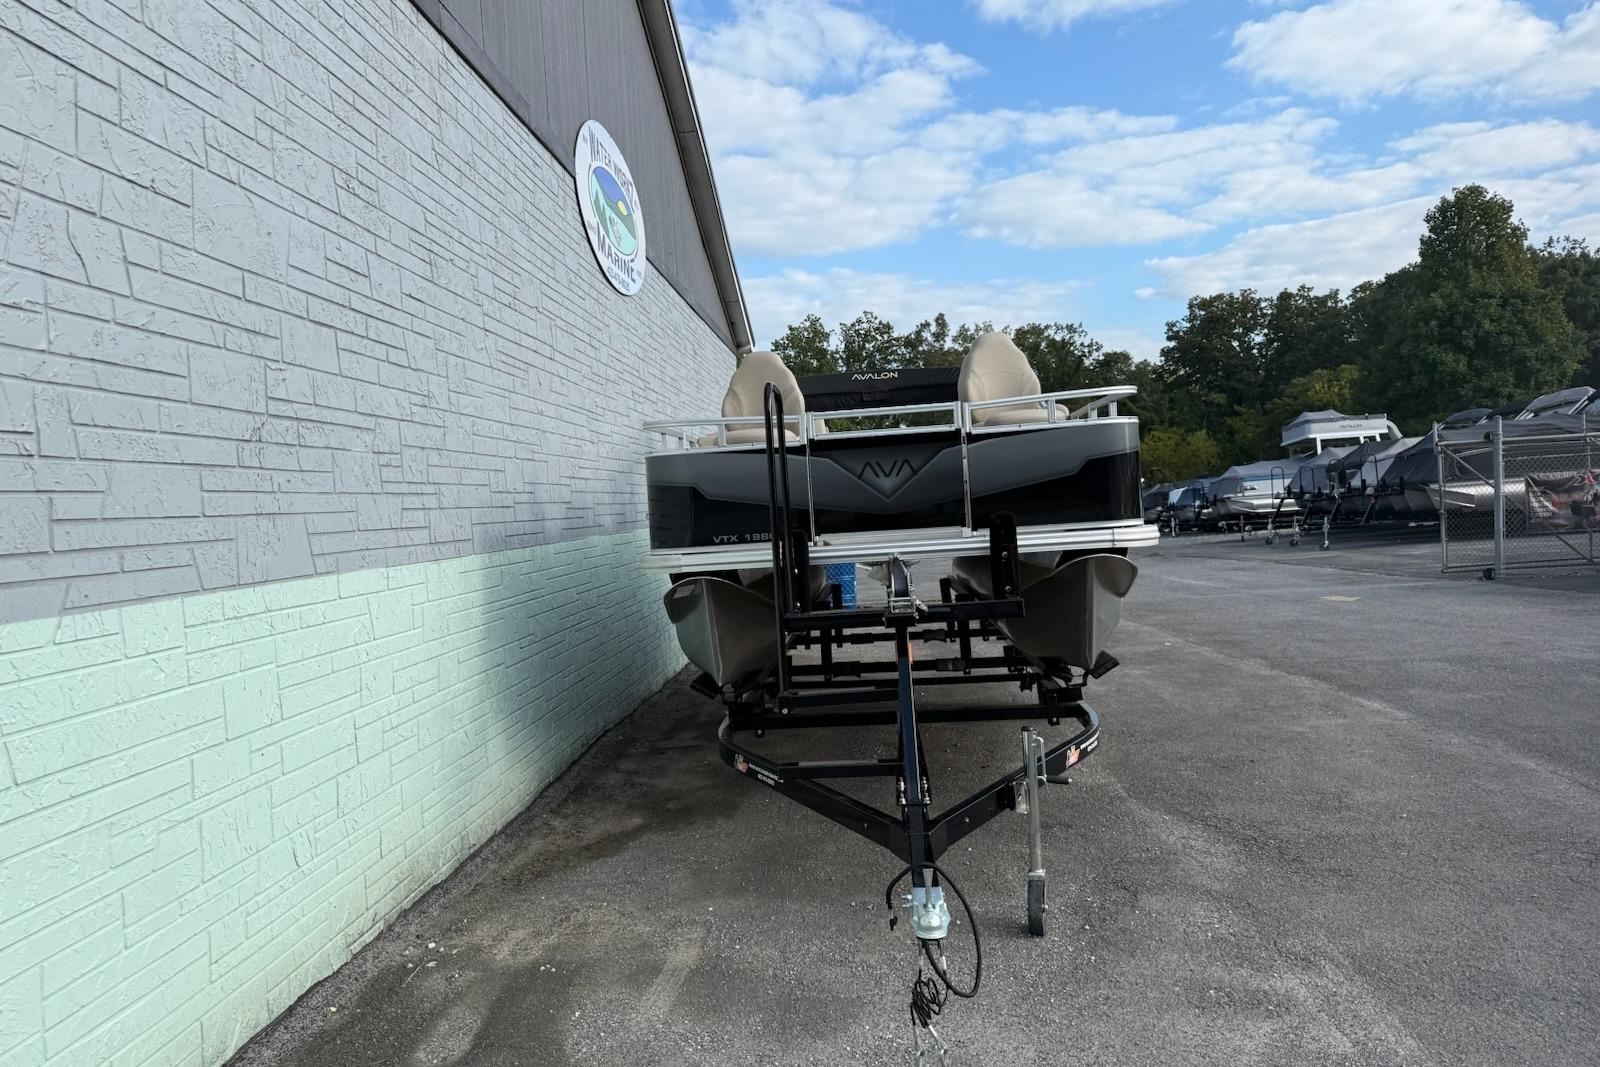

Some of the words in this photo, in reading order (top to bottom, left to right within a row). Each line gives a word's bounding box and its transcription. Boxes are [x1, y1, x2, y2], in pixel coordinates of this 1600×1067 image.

[597, 221, 636, 284] MARINE
[851, 371, 899, 381] AVALON
[859, 459, 917, 479] AVA
[712, 534, 739, 544] VTX
